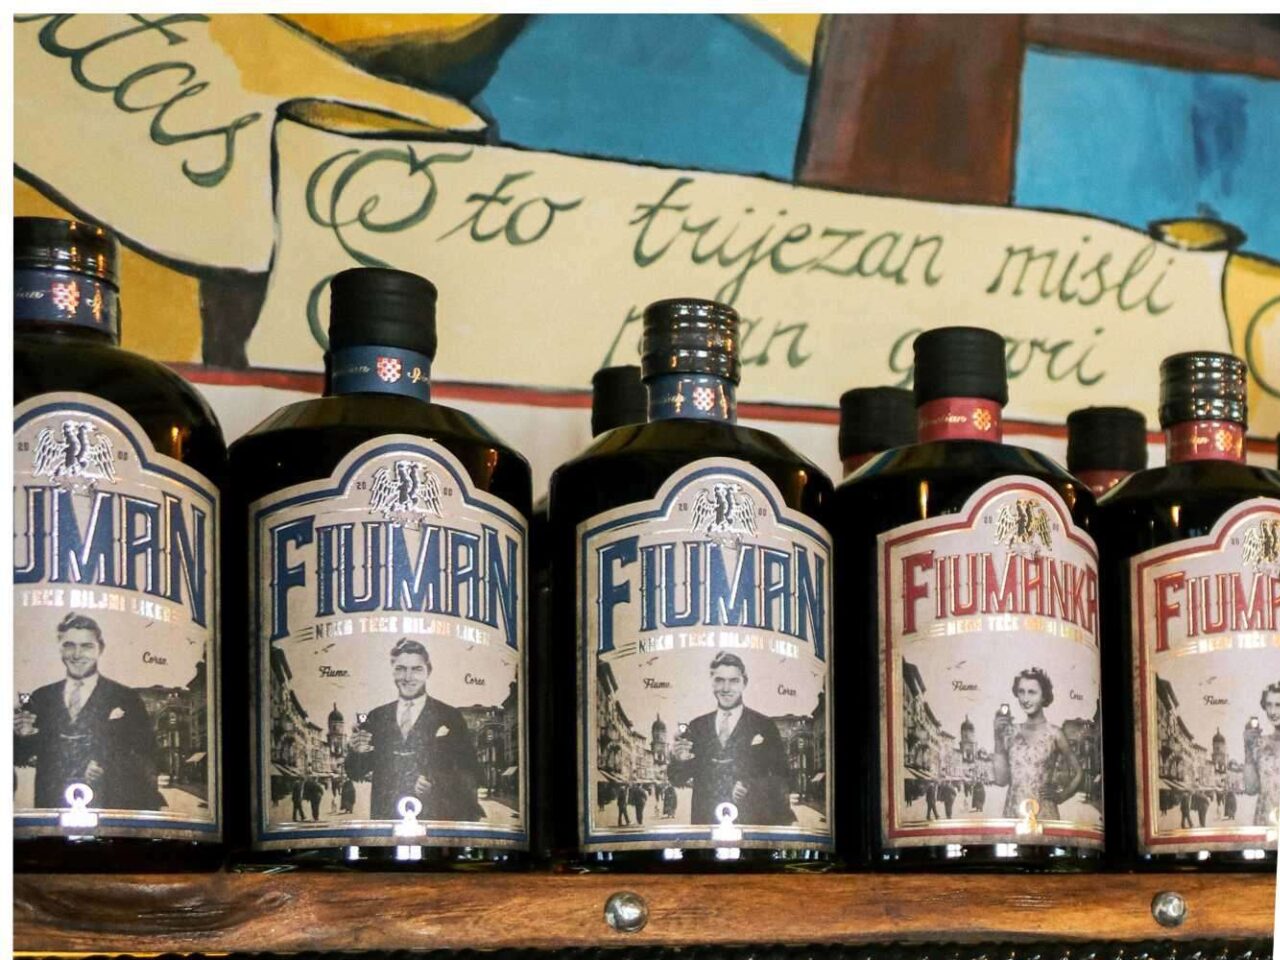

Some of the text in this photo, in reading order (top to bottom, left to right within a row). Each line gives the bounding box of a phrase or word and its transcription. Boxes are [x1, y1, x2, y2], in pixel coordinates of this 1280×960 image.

[629, 177, 944, 305] trijezan
[986, 235, 1174, 315] misli
[270, 515, 519, 651] FIUMAN
[596, 535, 826, 663] FIUMAN
[901, 549, 1099, 648] FIUMANKA
